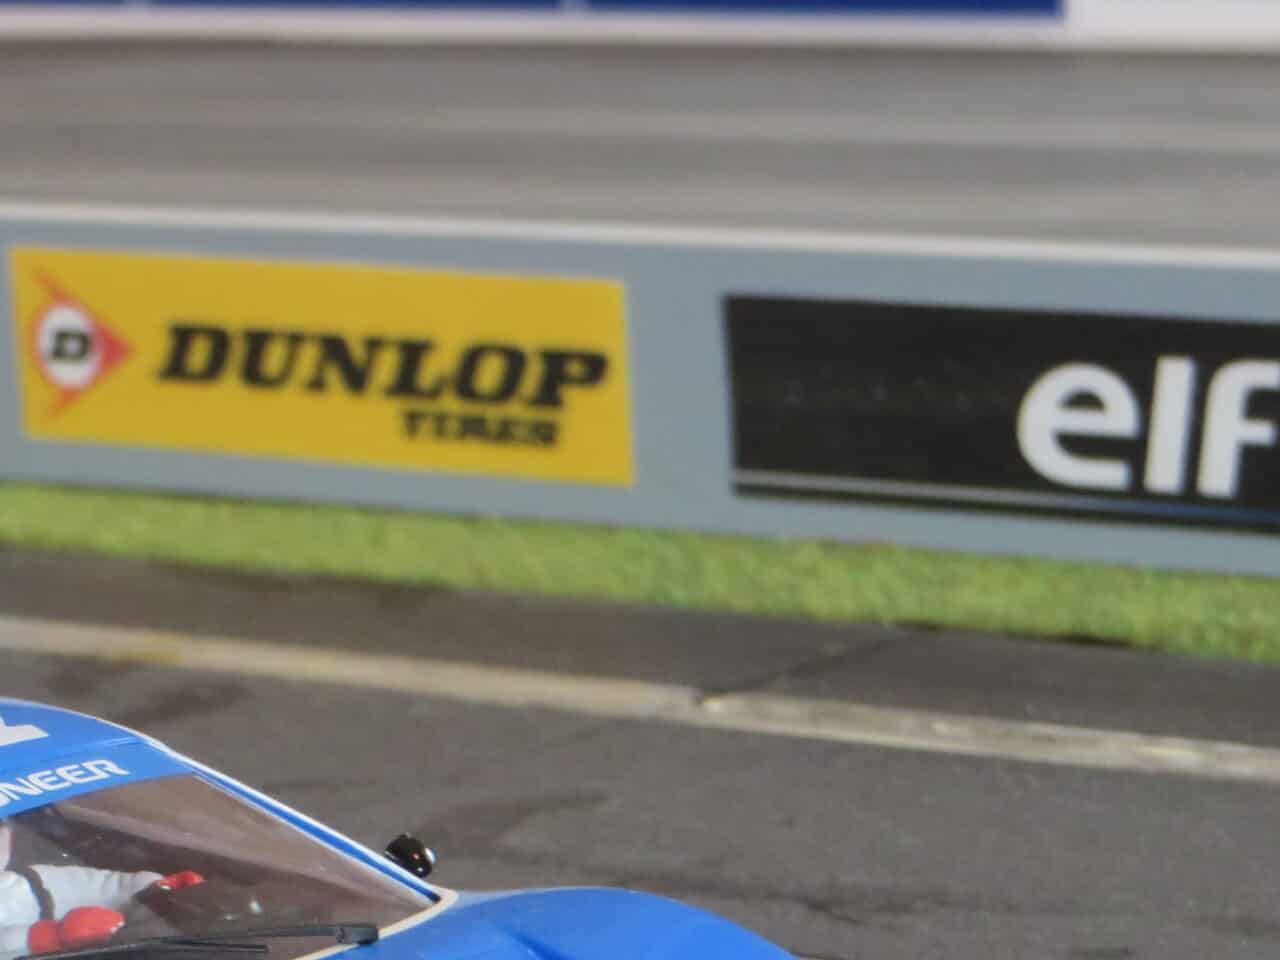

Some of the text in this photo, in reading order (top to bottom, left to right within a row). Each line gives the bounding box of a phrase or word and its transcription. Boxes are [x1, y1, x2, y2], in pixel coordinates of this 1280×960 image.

[155, 322, 610, 410] DUNLOP
[401, 409, 560, 449] TIRES
[1017, 356, 1280, 499] elf
